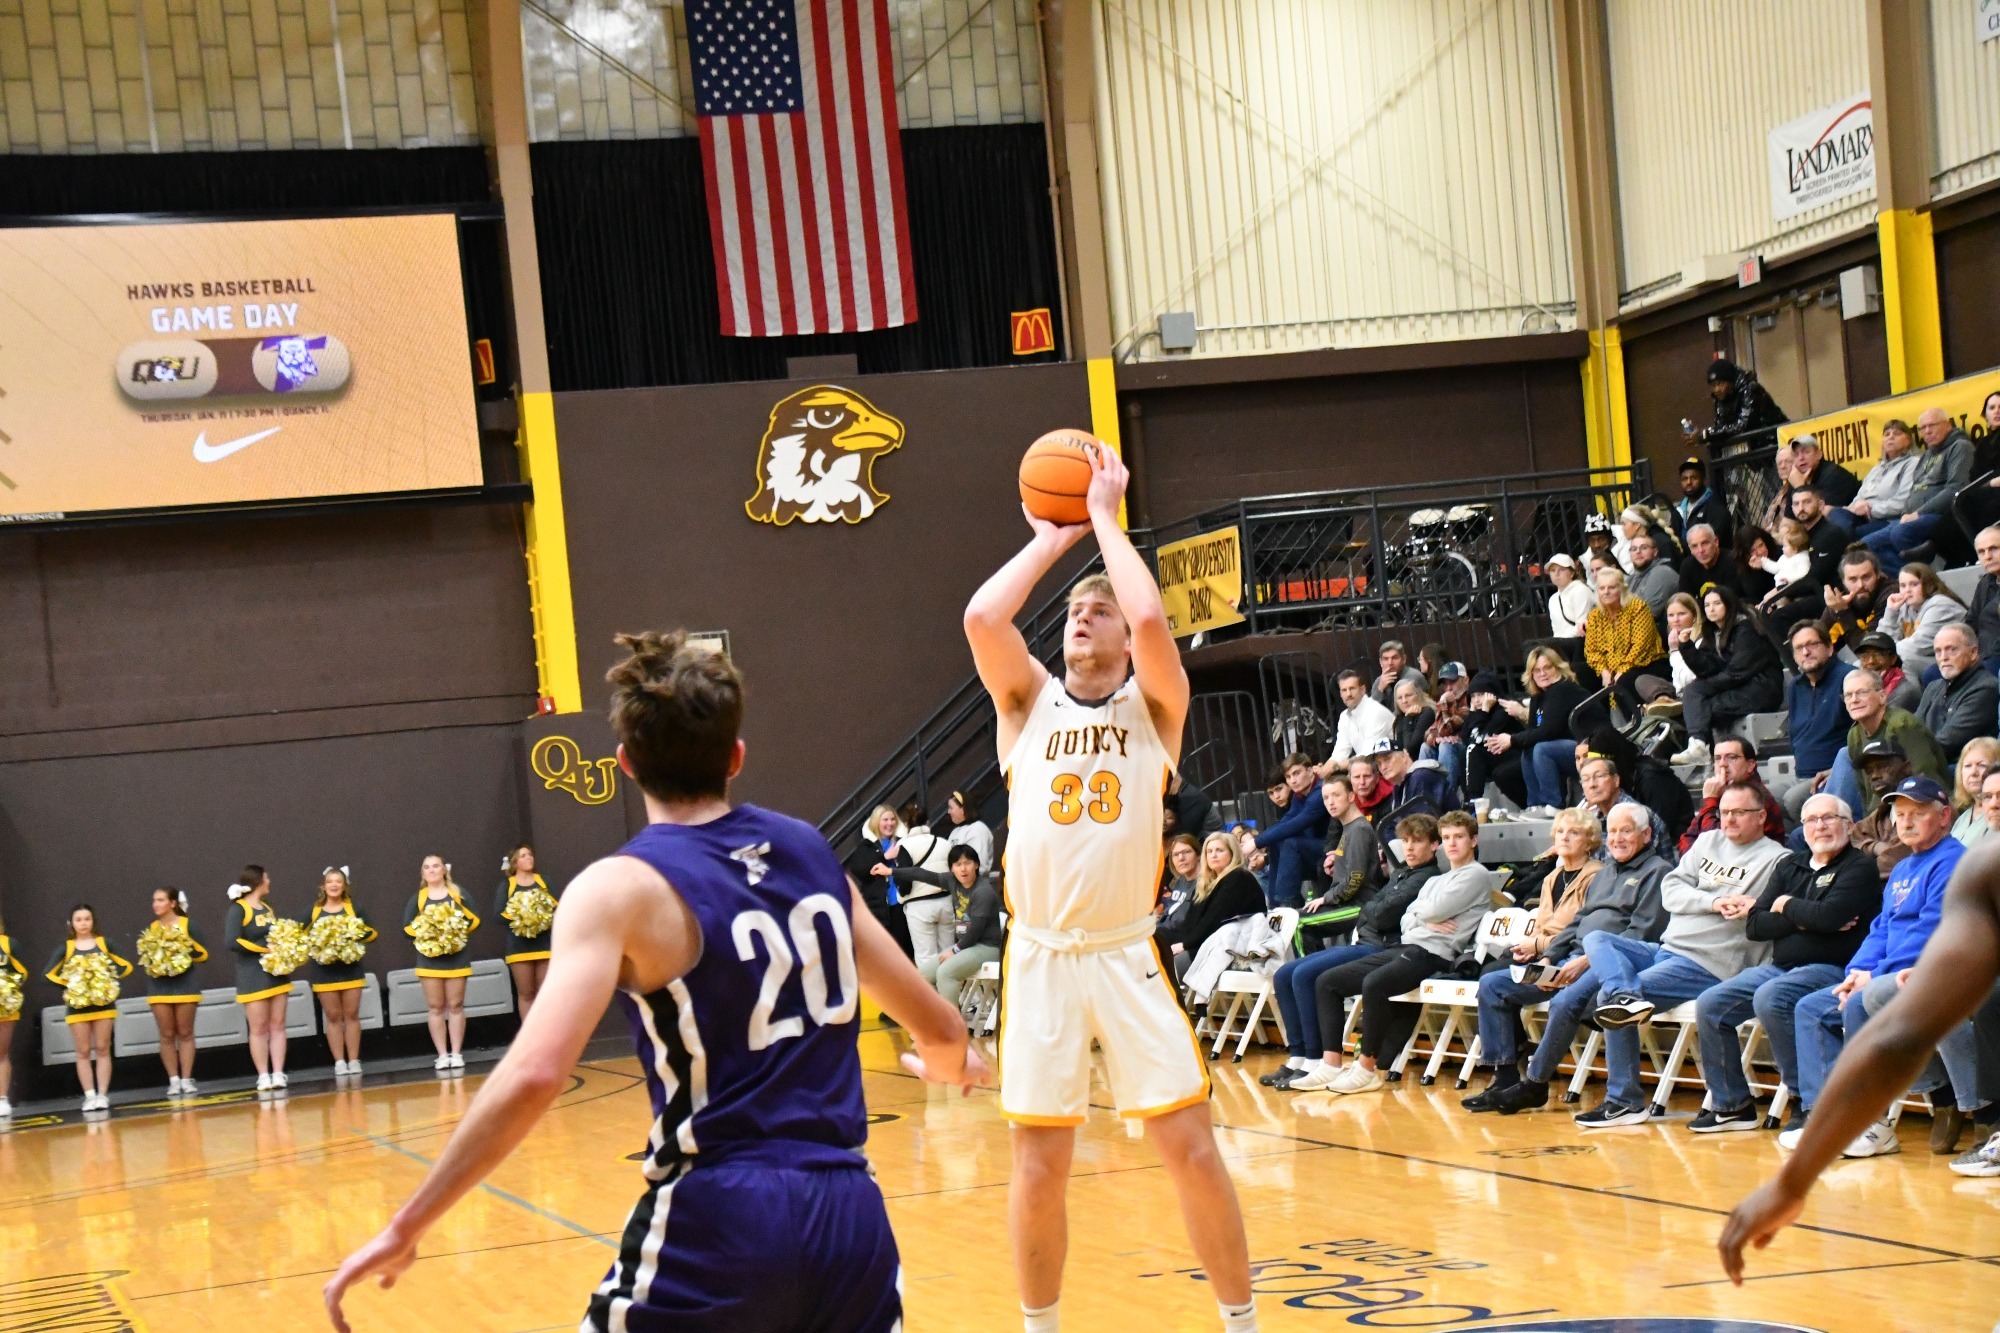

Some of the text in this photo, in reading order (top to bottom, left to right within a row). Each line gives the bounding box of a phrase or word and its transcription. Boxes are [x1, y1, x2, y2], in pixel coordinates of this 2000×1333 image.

[126, 278, 316, 300] HAWKS BASKETBALL
[151, 302, 299, 333] GAME DAY
[1158, 535, 1237, 589] QUINCY UNIVERSITY
[1188, 586, 1213, 624] BAND
[531, 735, 618, 805] QU
[1049, 770, 1123, 825] 33
[731, 893, 860, 1051] 20
